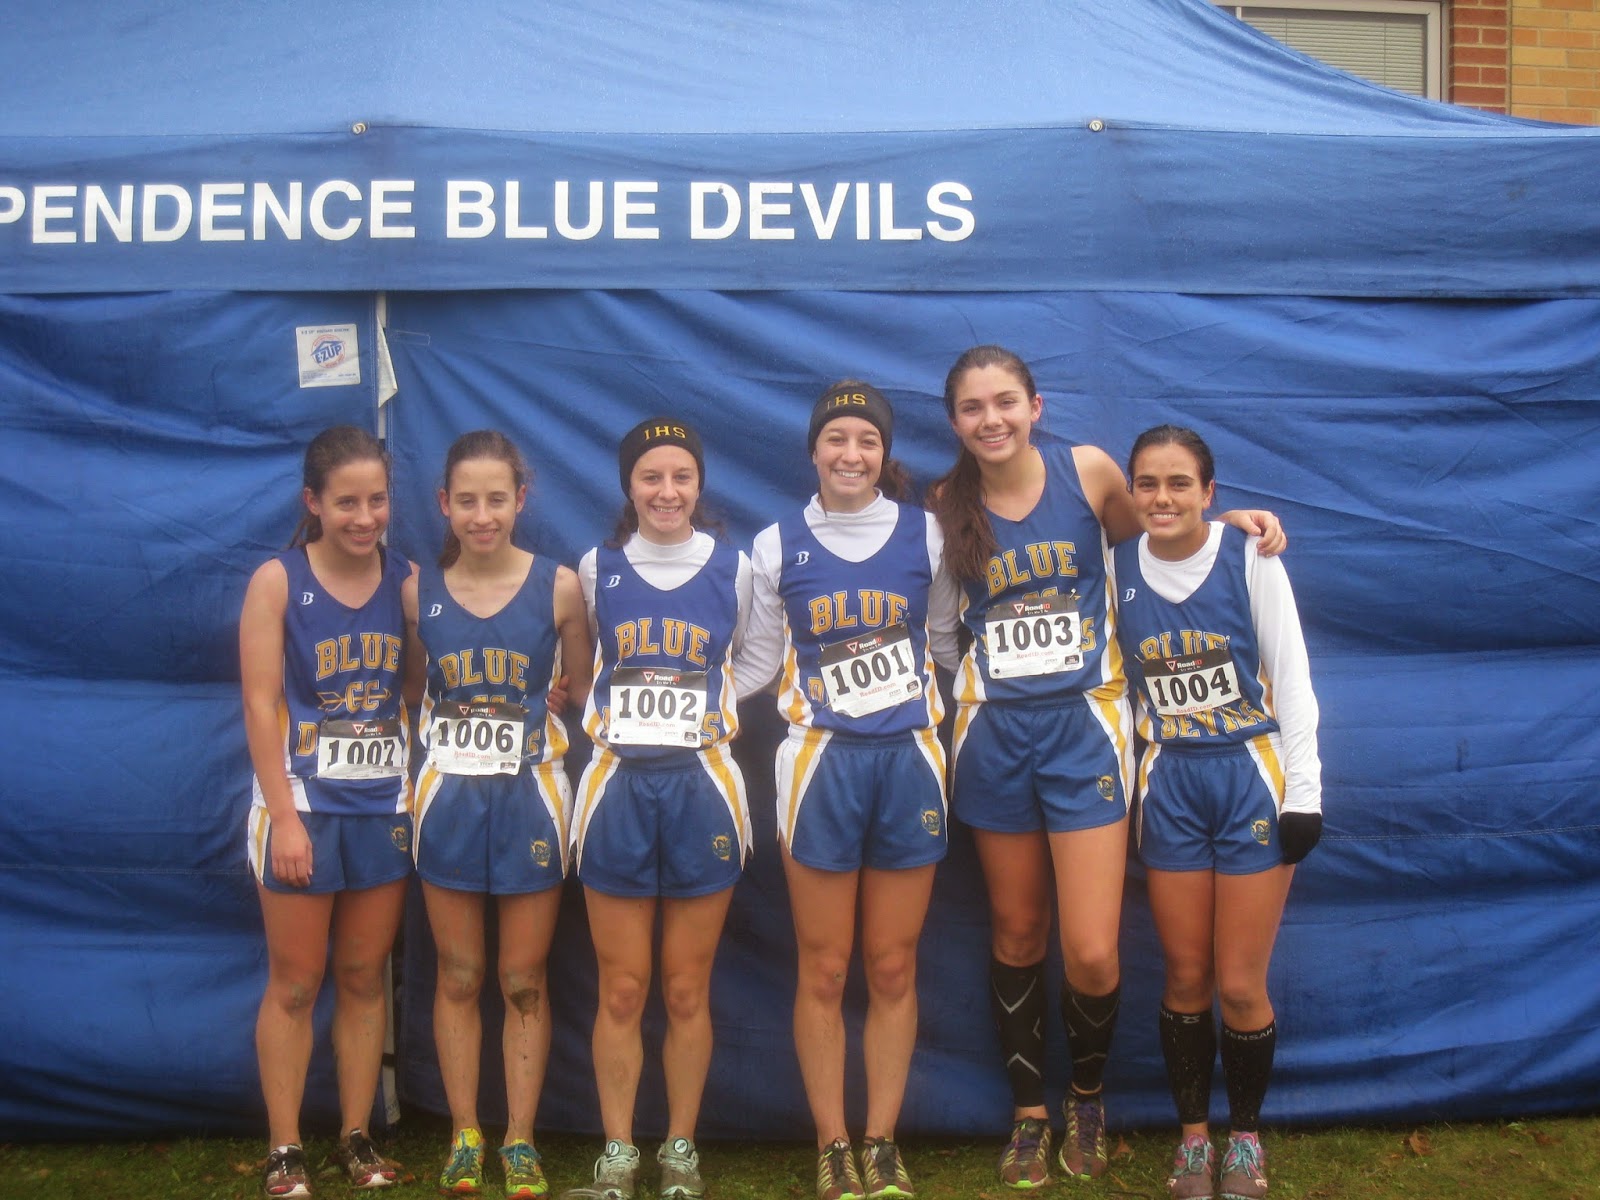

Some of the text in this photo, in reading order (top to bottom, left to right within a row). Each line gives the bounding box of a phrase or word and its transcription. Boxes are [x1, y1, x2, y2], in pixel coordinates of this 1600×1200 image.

[446, 180, 660, 242] BLUE
[690, 181, 975, 243] DEVILS
[827, 393, 867, 410] IHS
[644, 425, 687, 440] IHS
[984, 541, 1079, 598] BLUE
[808, 589, 908, 635] BLUE
[615, 617, 710, 668] BLUE
[994, 615, 1073, 653] 1003
[315, 632, 402, 681] BLUE
[438, 648, 530, 691] BLUE
[830, 645, 910, 696] 1001
[619, 688, 697, 722] 1002
[1153, 667, 1232, 707] 1004
[327, 740, 395, 767] 1007
[438, 719, 515, 753] 1006
